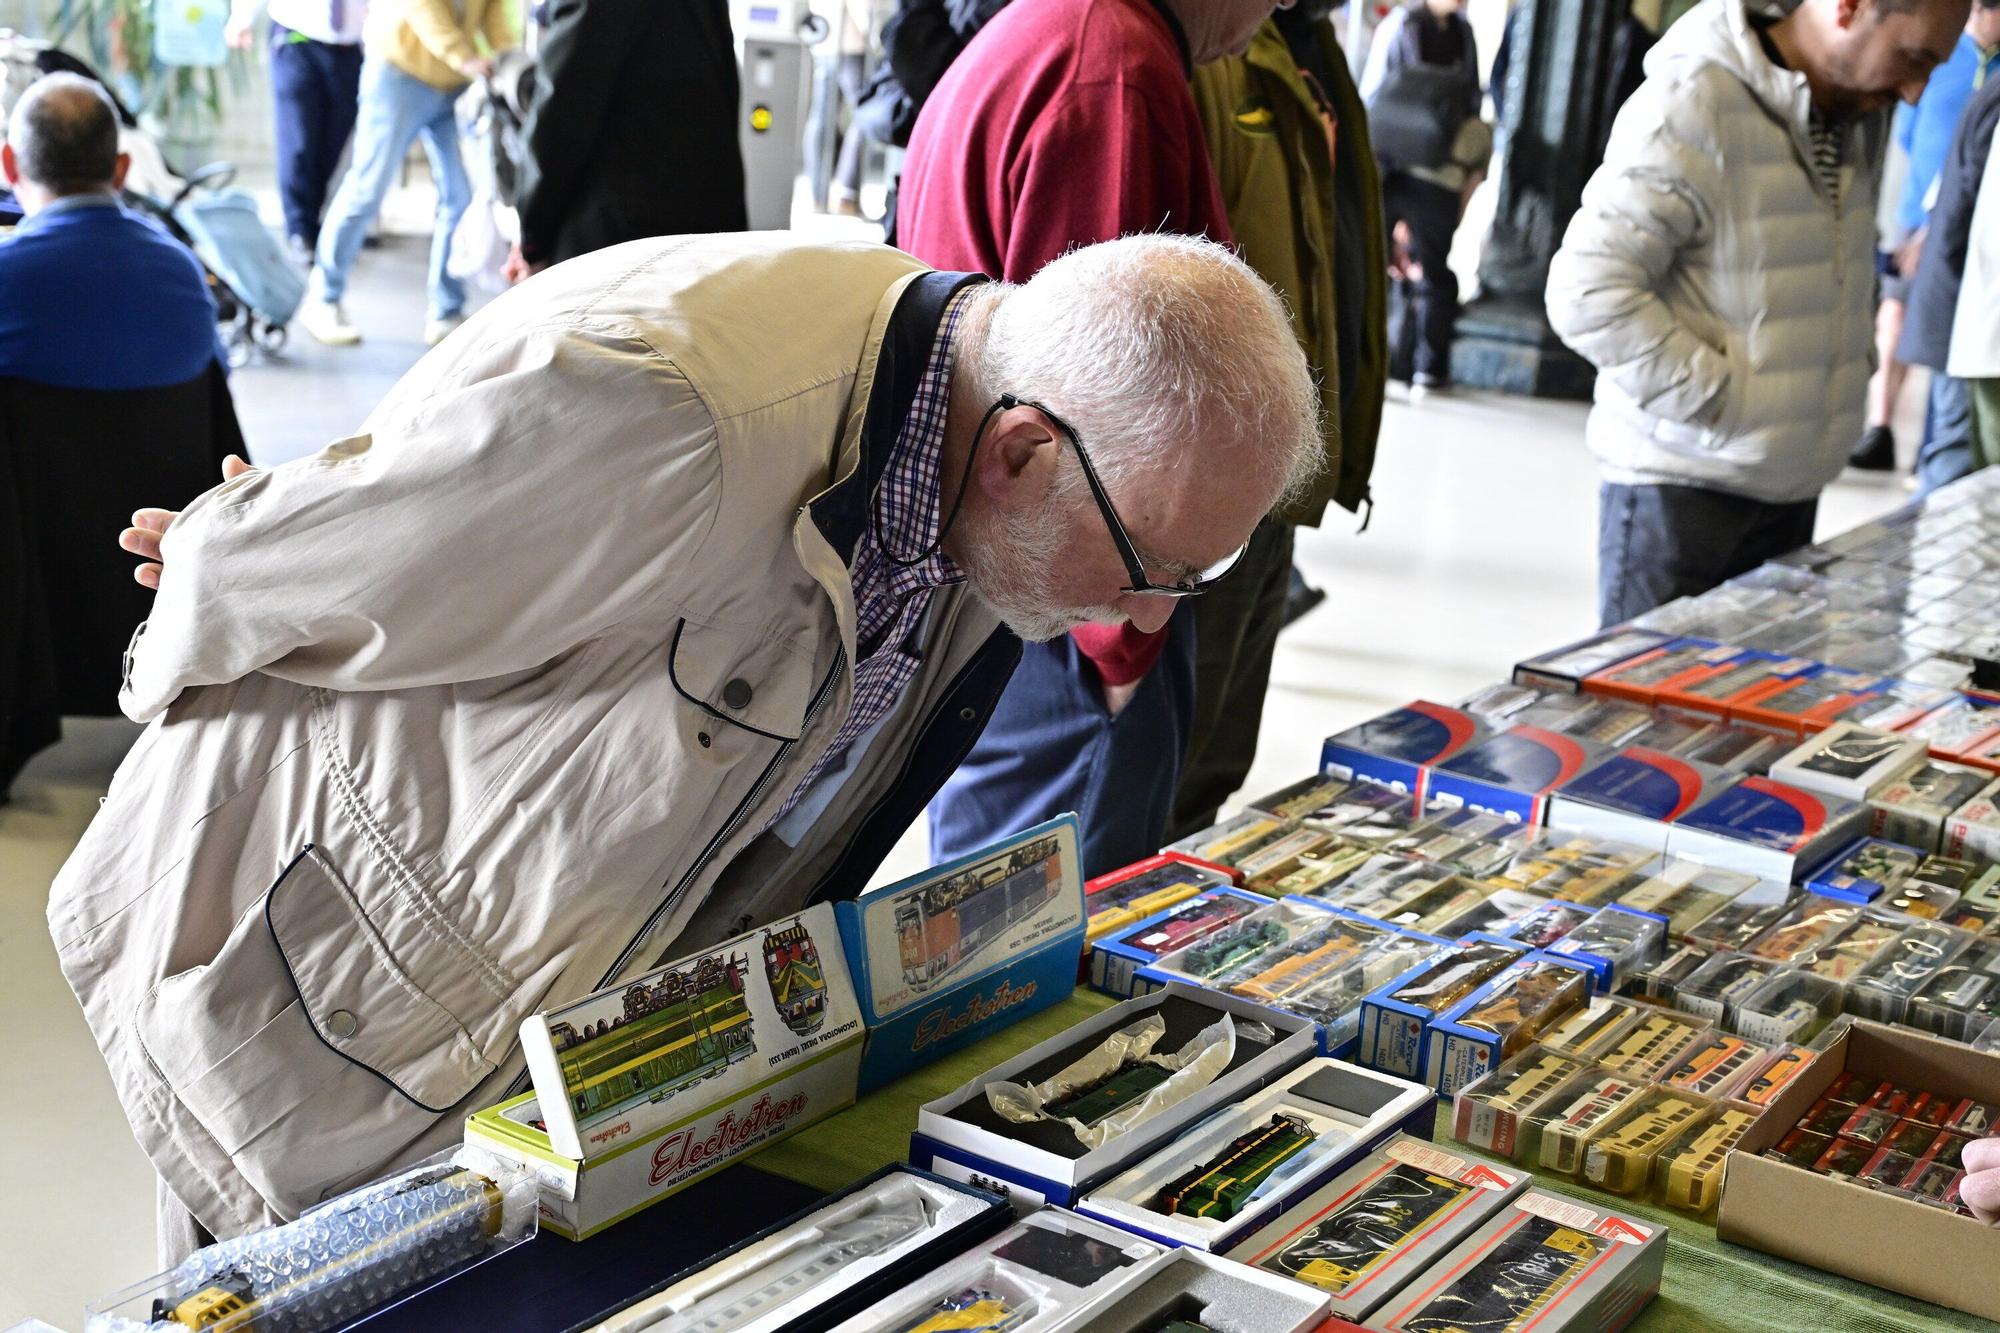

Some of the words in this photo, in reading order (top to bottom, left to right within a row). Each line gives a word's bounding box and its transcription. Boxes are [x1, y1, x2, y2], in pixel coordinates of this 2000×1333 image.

[911, 979, 1038, 1051] Electrotren
[819, 1019, 858, 1043] LOCOMOTORA
[801, 1038, 819, 1050] DIESEL
[768, 1052, 782, 1068] 333)
[1443, 1072, 1452, 1094] 1405
[648, 1091, 808, 1187] Electrotren
[1497, 1112, 1510, 1150] WIKING
